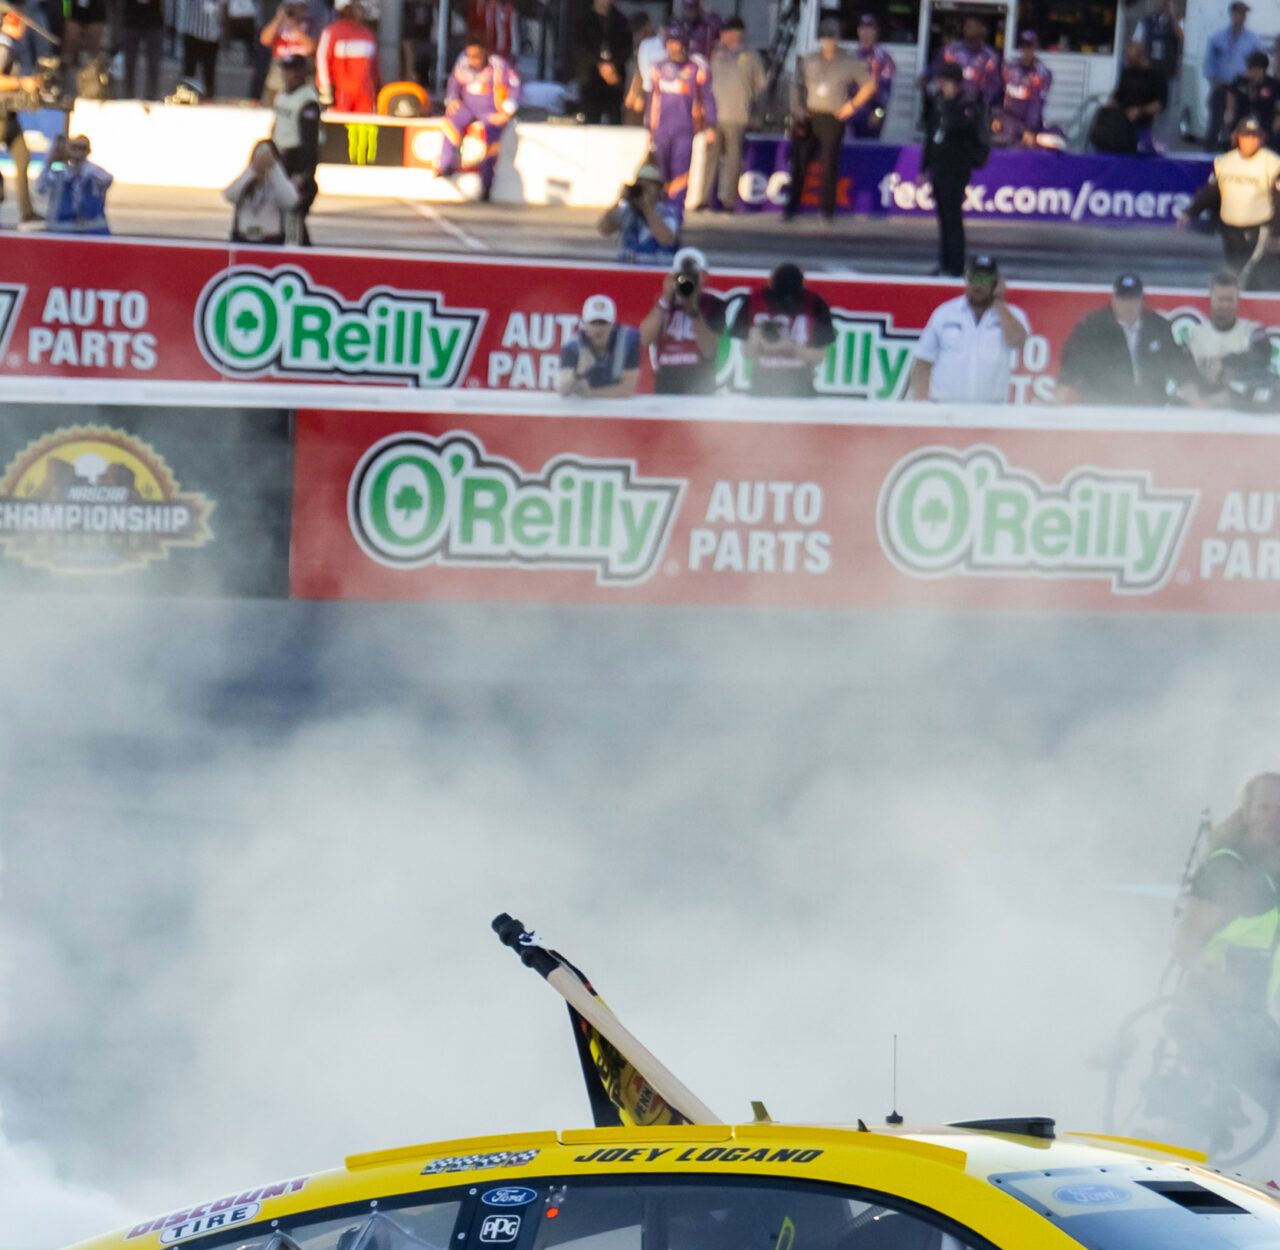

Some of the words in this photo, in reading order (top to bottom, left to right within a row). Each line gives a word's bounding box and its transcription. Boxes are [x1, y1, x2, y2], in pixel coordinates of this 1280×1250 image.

[42, 286, 147, 329] AUTO
[28, 328, 157, 370] PARTS
[214, 283, 461, 379] O'Reilly
[502, 312, 581, 350] AUT
[488, 352, 561, 391] PAR
[370, 453, 659, 564] O'Reilly
[706, 480, 823, 525] AUTO
[896, 465, 1172, 572] O'Reilly
[688, 529, 832, 573] PARTS
[573, 1148, 674, 1163] JOEY
[675, 1148, 825, 1163] LOGANO
[125, 1176, 310, 1240] DISCOUNT
[489, 1188, 530, 1204] Ford
[171, 1206, 249, 1239] TIRE
[482, 1217, 518, 1240] PPG
